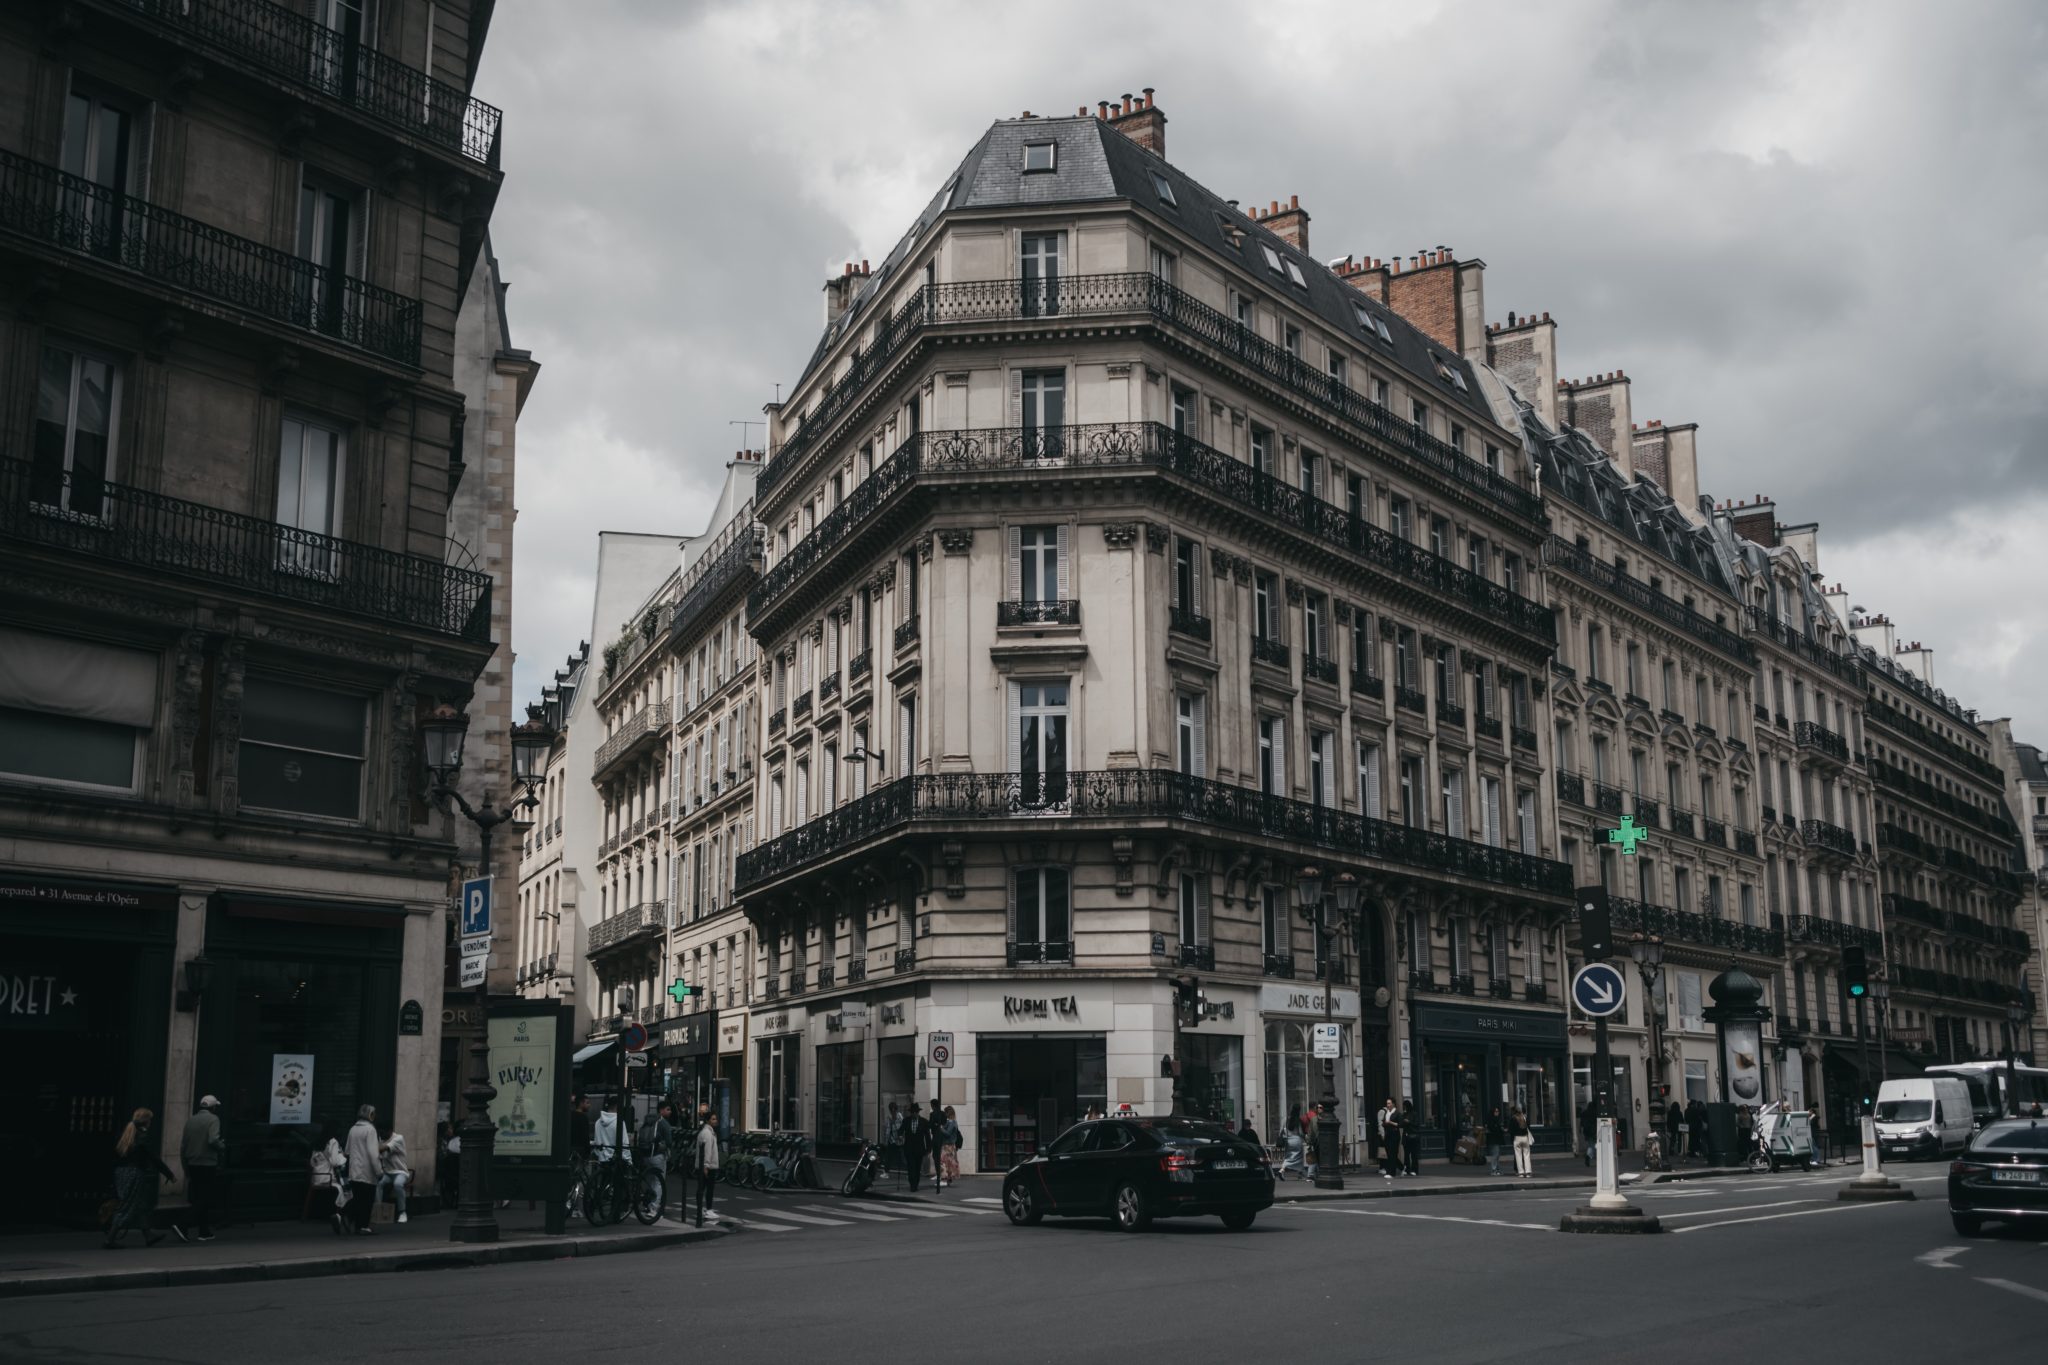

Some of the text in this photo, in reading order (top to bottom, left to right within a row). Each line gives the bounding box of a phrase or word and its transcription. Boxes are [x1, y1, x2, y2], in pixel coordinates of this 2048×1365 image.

[0, 886, 139, 906] repared 31 Avenue de l'Opéra
[470, 889, 483, 925] P
[463, 939, 488, 952] VENDÔME
[1004, 995, 1078, 1016] KUSMI TEA
[1288, 993, 1341, 1011] JADE GEIN
[1478, 1019, 1517, 1030] PARIS MIKI
[936, 1050, 946, 1058] 30
